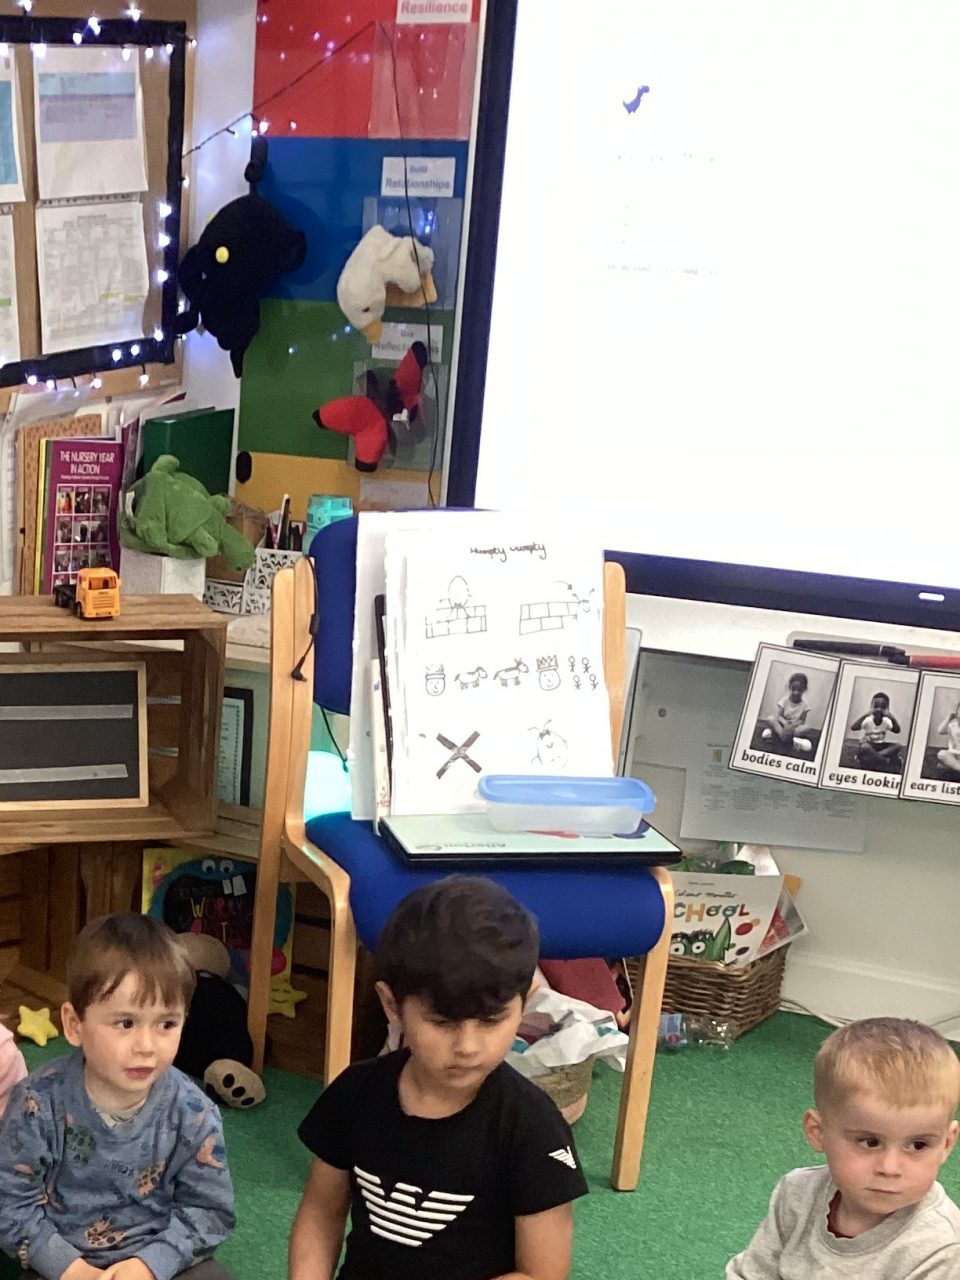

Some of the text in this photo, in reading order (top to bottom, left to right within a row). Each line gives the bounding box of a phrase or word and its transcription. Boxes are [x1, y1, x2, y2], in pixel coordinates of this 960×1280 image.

[400, 1, 468, 14] Resilience
[385, 177, 451, 190] Relaionships
[60, 451, 115, 463] THE NURSERY YEAR
[77, 464, 100, 474] ACTION
[741, 749, 782, 768] bodies
[785, 761, 817, 776] calm
[828, 772, 858, 785] eyes
[910, 782, 937, 793] ears
[673, 901, 750, 923] CHOOL
